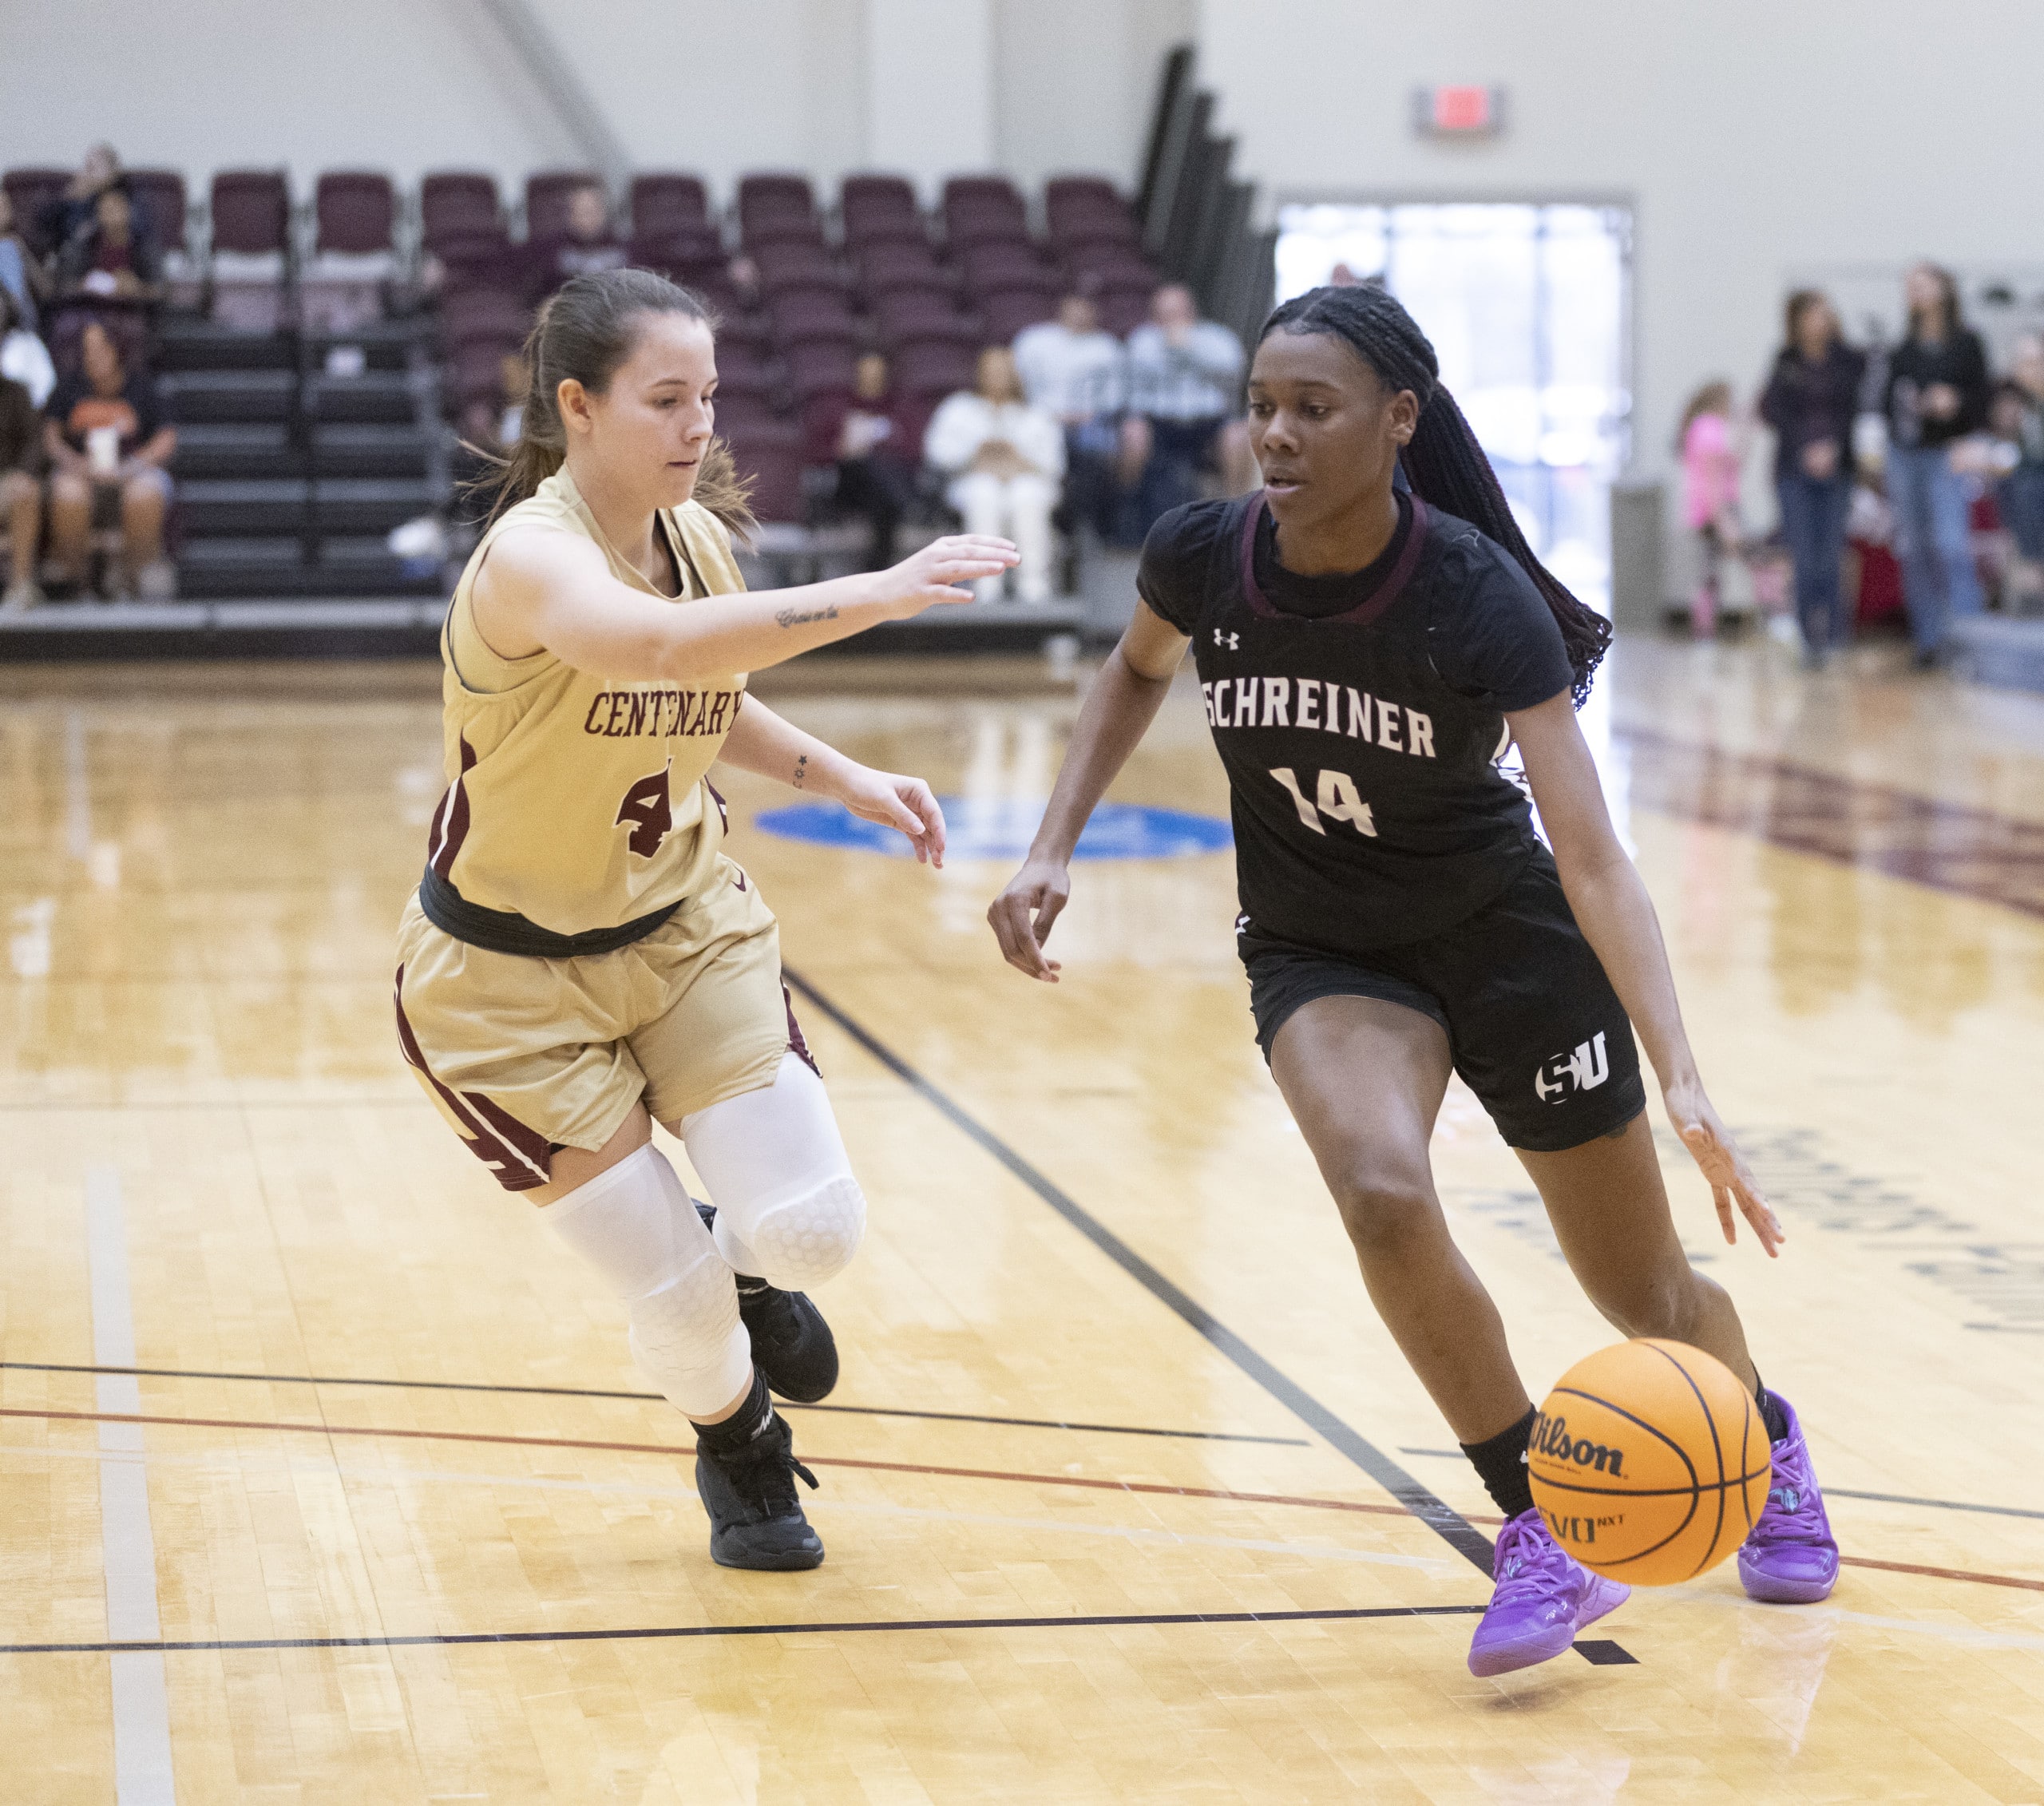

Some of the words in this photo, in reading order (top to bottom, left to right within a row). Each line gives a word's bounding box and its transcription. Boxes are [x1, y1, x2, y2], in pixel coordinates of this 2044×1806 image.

[584, 689, 744, 737] CENTENARY
[1202, 677, 1436, 758] SCHREINER
[612, 756, 672, 861] 4
[1269, 767, 1379, 838] 14
[1535, 1030, 1609, 1105] SU
[1598, 1514, 1624, 1527] NXT
